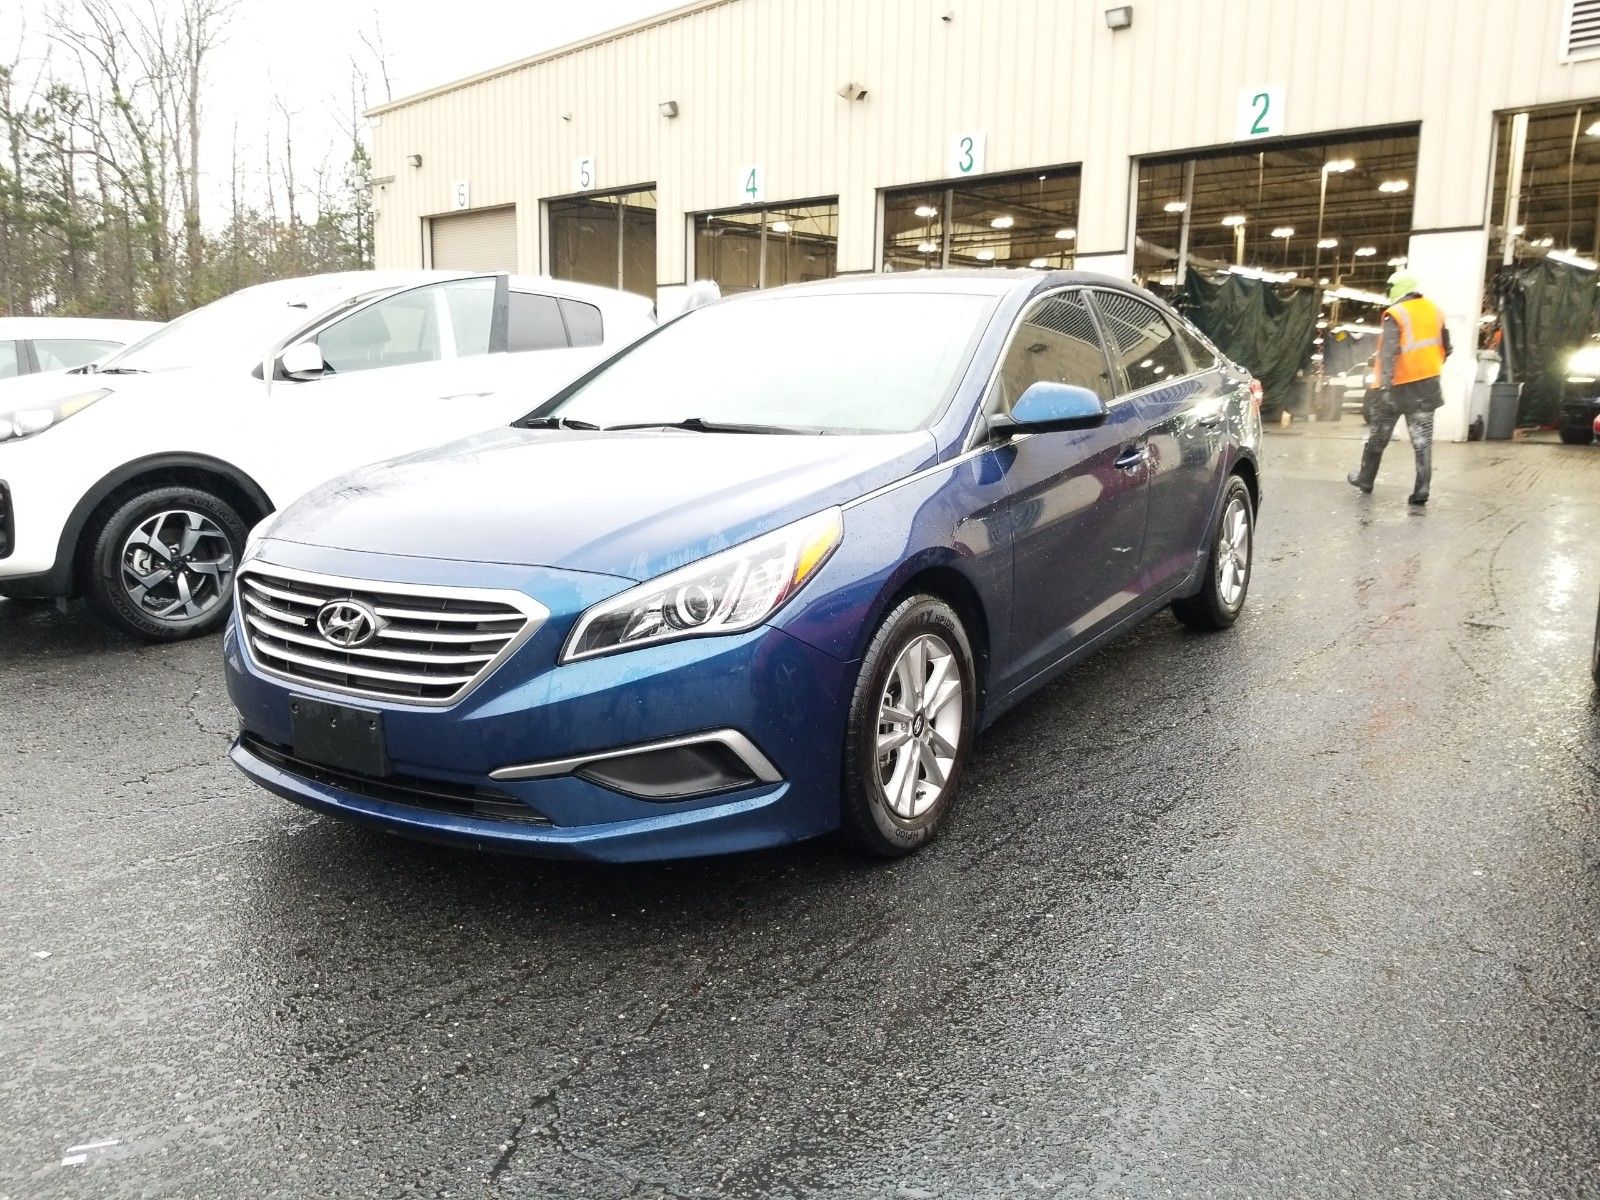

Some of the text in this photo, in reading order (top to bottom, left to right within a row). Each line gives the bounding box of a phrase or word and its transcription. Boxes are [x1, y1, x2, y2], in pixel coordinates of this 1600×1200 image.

[1250, 93, 1270, 135] 2
[959, 137, 974, 172] 3
[580, 160, 590, 188] 5
[745, 168, 758, 198] 4
[458, 183, 466, 207] 6
